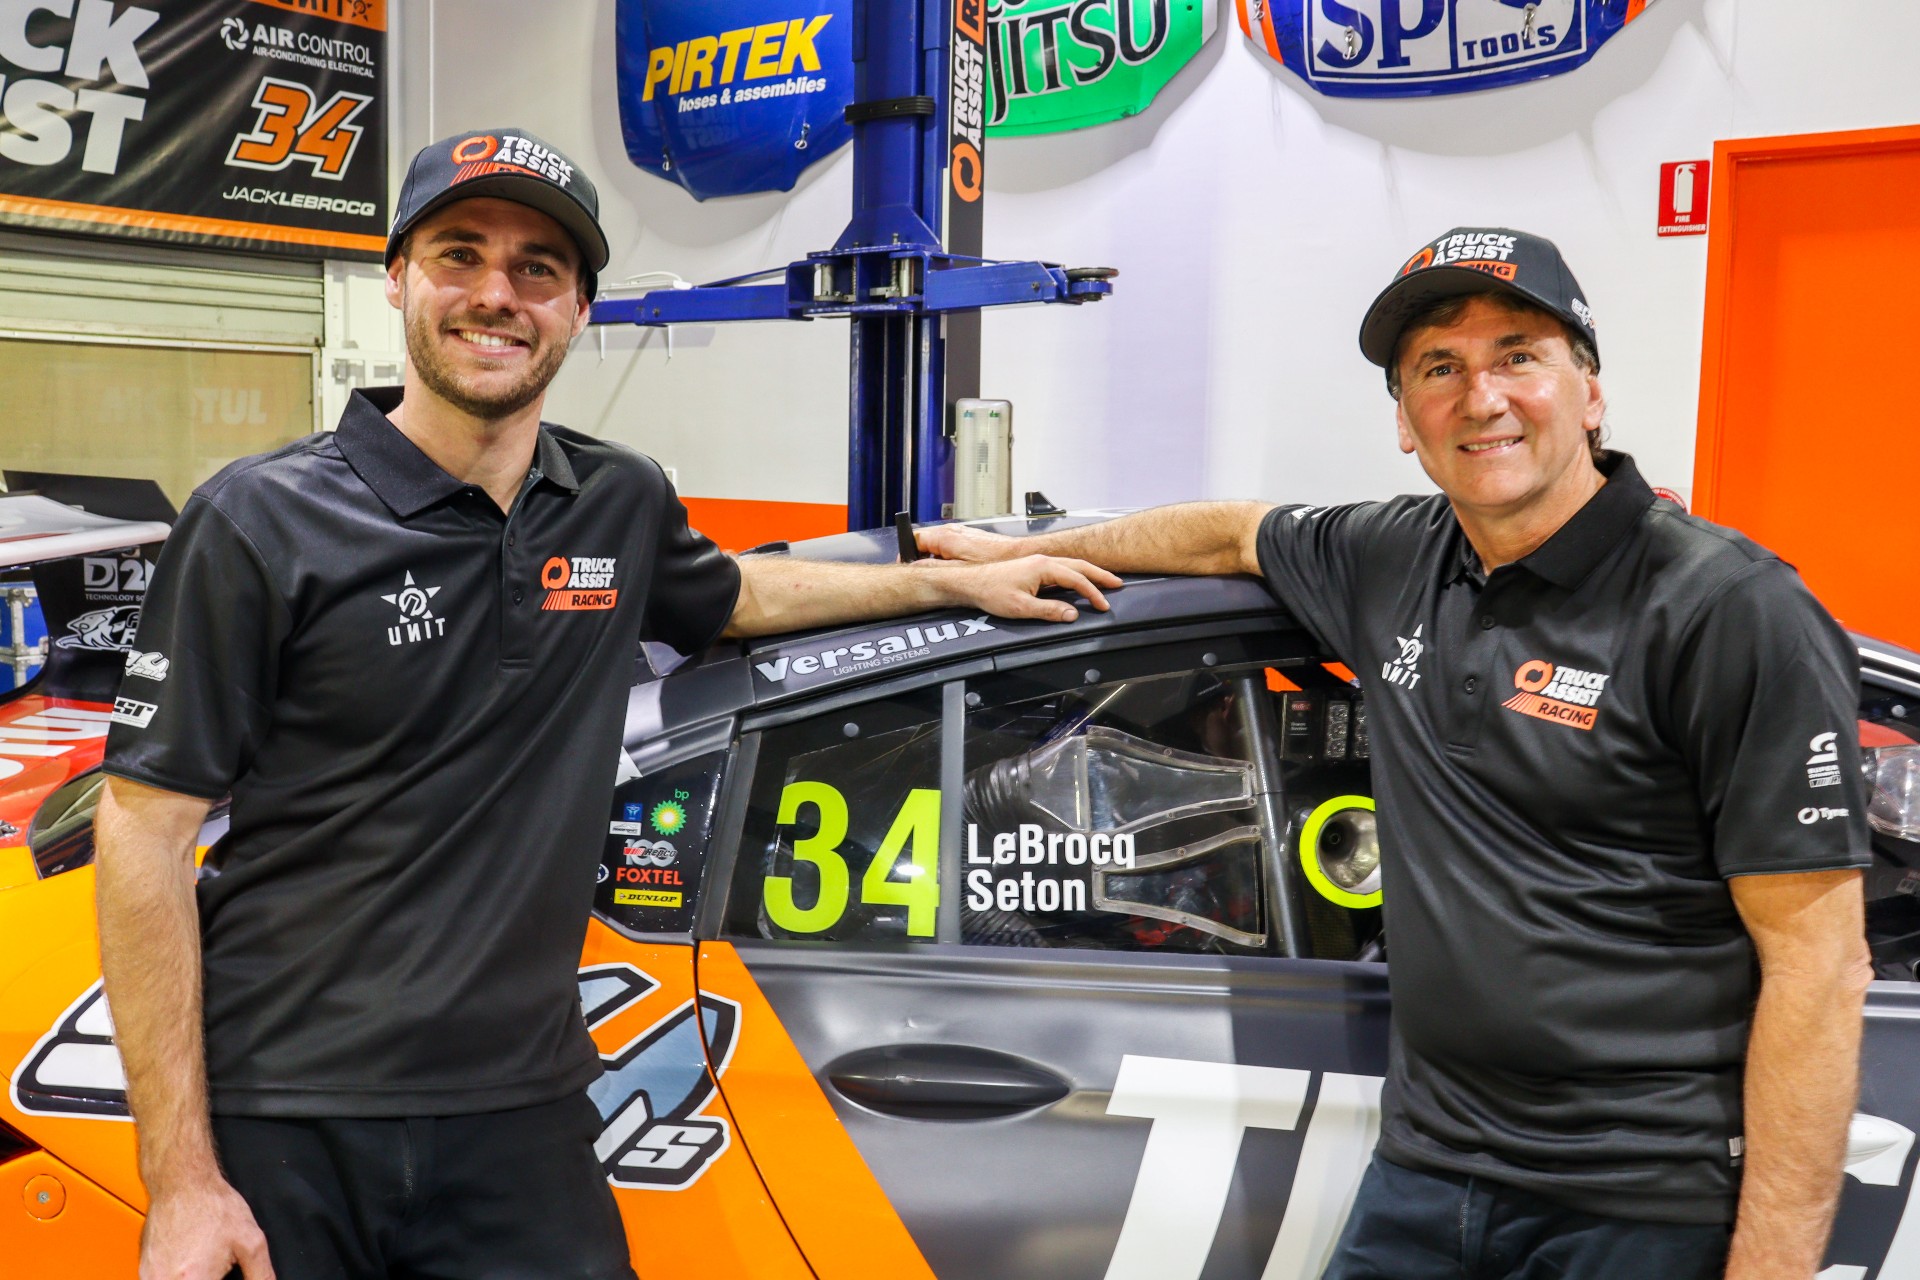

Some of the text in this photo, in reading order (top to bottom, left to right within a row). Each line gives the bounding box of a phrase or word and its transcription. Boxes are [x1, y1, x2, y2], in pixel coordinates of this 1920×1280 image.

[252, 24, 375, 66] AIR CONTROL
[1463, 25, 1557, 60] TOOLS
[252, 47, 375, 78] AIR-CONDITIONING ELECTRICAL
[642, 14, 833, 102] PIRTEK
[678, 79, 826, 112] hoses & assemblies
[954, 32, 971, 137] TRUCK
[966, 42, 984, 152] ASSIST
[225, 76, 374, 181] 34
[493, 147, 571, 188] ASSIST
[502, 135, 574, 177] TRUCK
[1658, 223, 1707, 233] EXTINGUISHER
[1674, 214, 1691, 223] FIRE
[1431, 244, 1514, 267] ASSIST
[1437, 232, 1518, 252] TRUCK
[571, 557, 616, 573] TRUCK
[567, 572, 614, 589] ASSIST
[85, 593, 134, 601] TECHNOLOGY
[571, 594, 612, 606] RACING
[387, 618, 446, 646] UNIT
[832, 647, 931, 676] LIGHTING SYSTEMS
[1381, 661, 1421, 690] UNIT
[1552, 665, 1611, 691] TRUCK
[1540, 681, 1603, 707] ASSIST
[1538, 702, 1593, 726] RACING
[674, 788, 690, 801] bp
[624, 838, 675, 867] 100
[763, 780, 943, 938] 34
[967, 823, 1136, 868] LeBrocq
[616, 867, 684, 886] FOXTEL
[966, 868, 1087, 913] Seton
[627, 893, 678, 903] DUNLOP
